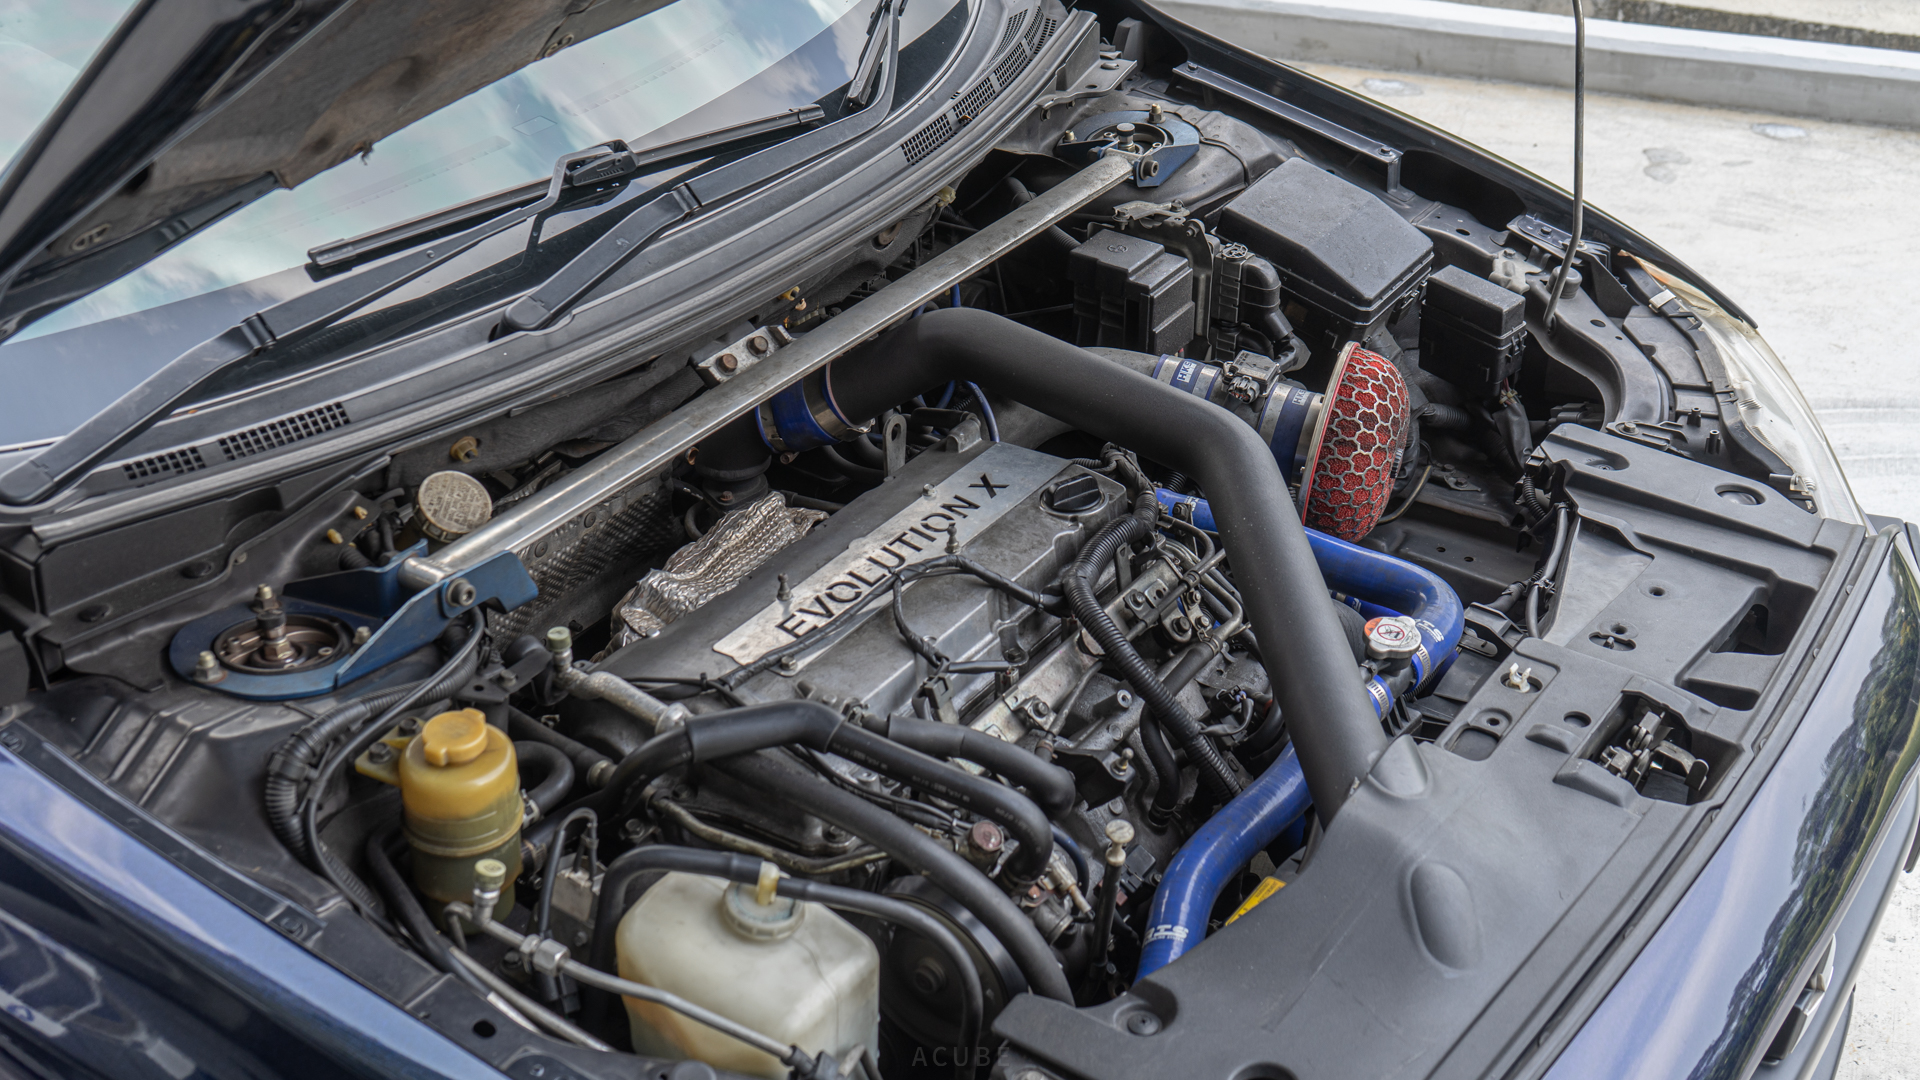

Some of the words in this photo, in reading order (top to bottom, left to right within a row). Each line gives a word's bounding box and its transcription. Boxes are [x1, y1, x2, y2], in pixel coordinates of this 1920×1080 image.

[1178, 361, 1192, 380] HKS
[775, 494, 981, 638] EVOLUTION
[968, 473, 1010, 498] X
